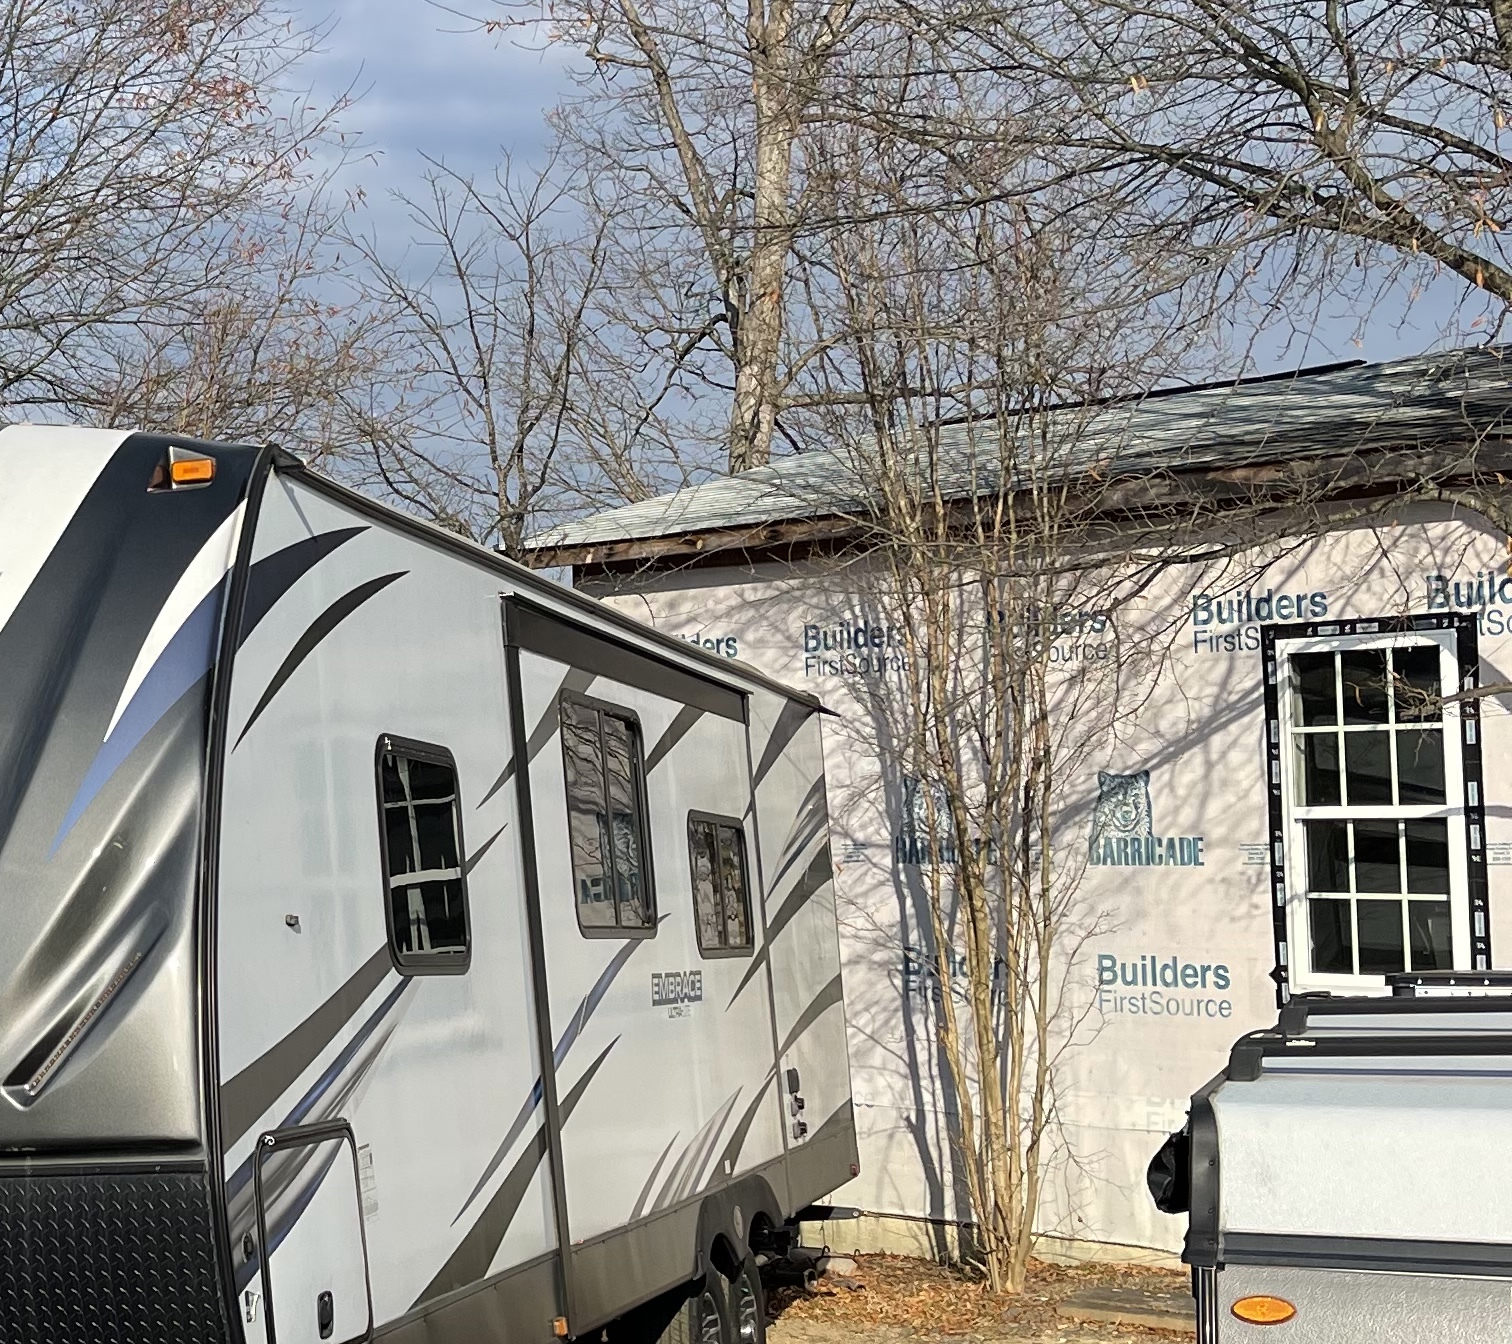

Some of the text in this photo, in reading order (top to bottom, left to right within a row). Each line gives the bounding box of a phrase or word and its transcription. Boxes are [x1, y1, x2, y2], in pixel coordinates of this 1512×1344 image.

[1192, 589, 1327, 626] Builders
[804, 620, 906, 653] Builders
[1193, 626, 1260, 654] FirstS
[804, 653, 910, 678] FirstSource
[1088, 836, 1205, 866] BARRICADE
[1098, 954, 1231, 990] Builders
[652, 972, 702, 1003] EMBRACE
[1098, 989, 1232, 1018] FirstSource
